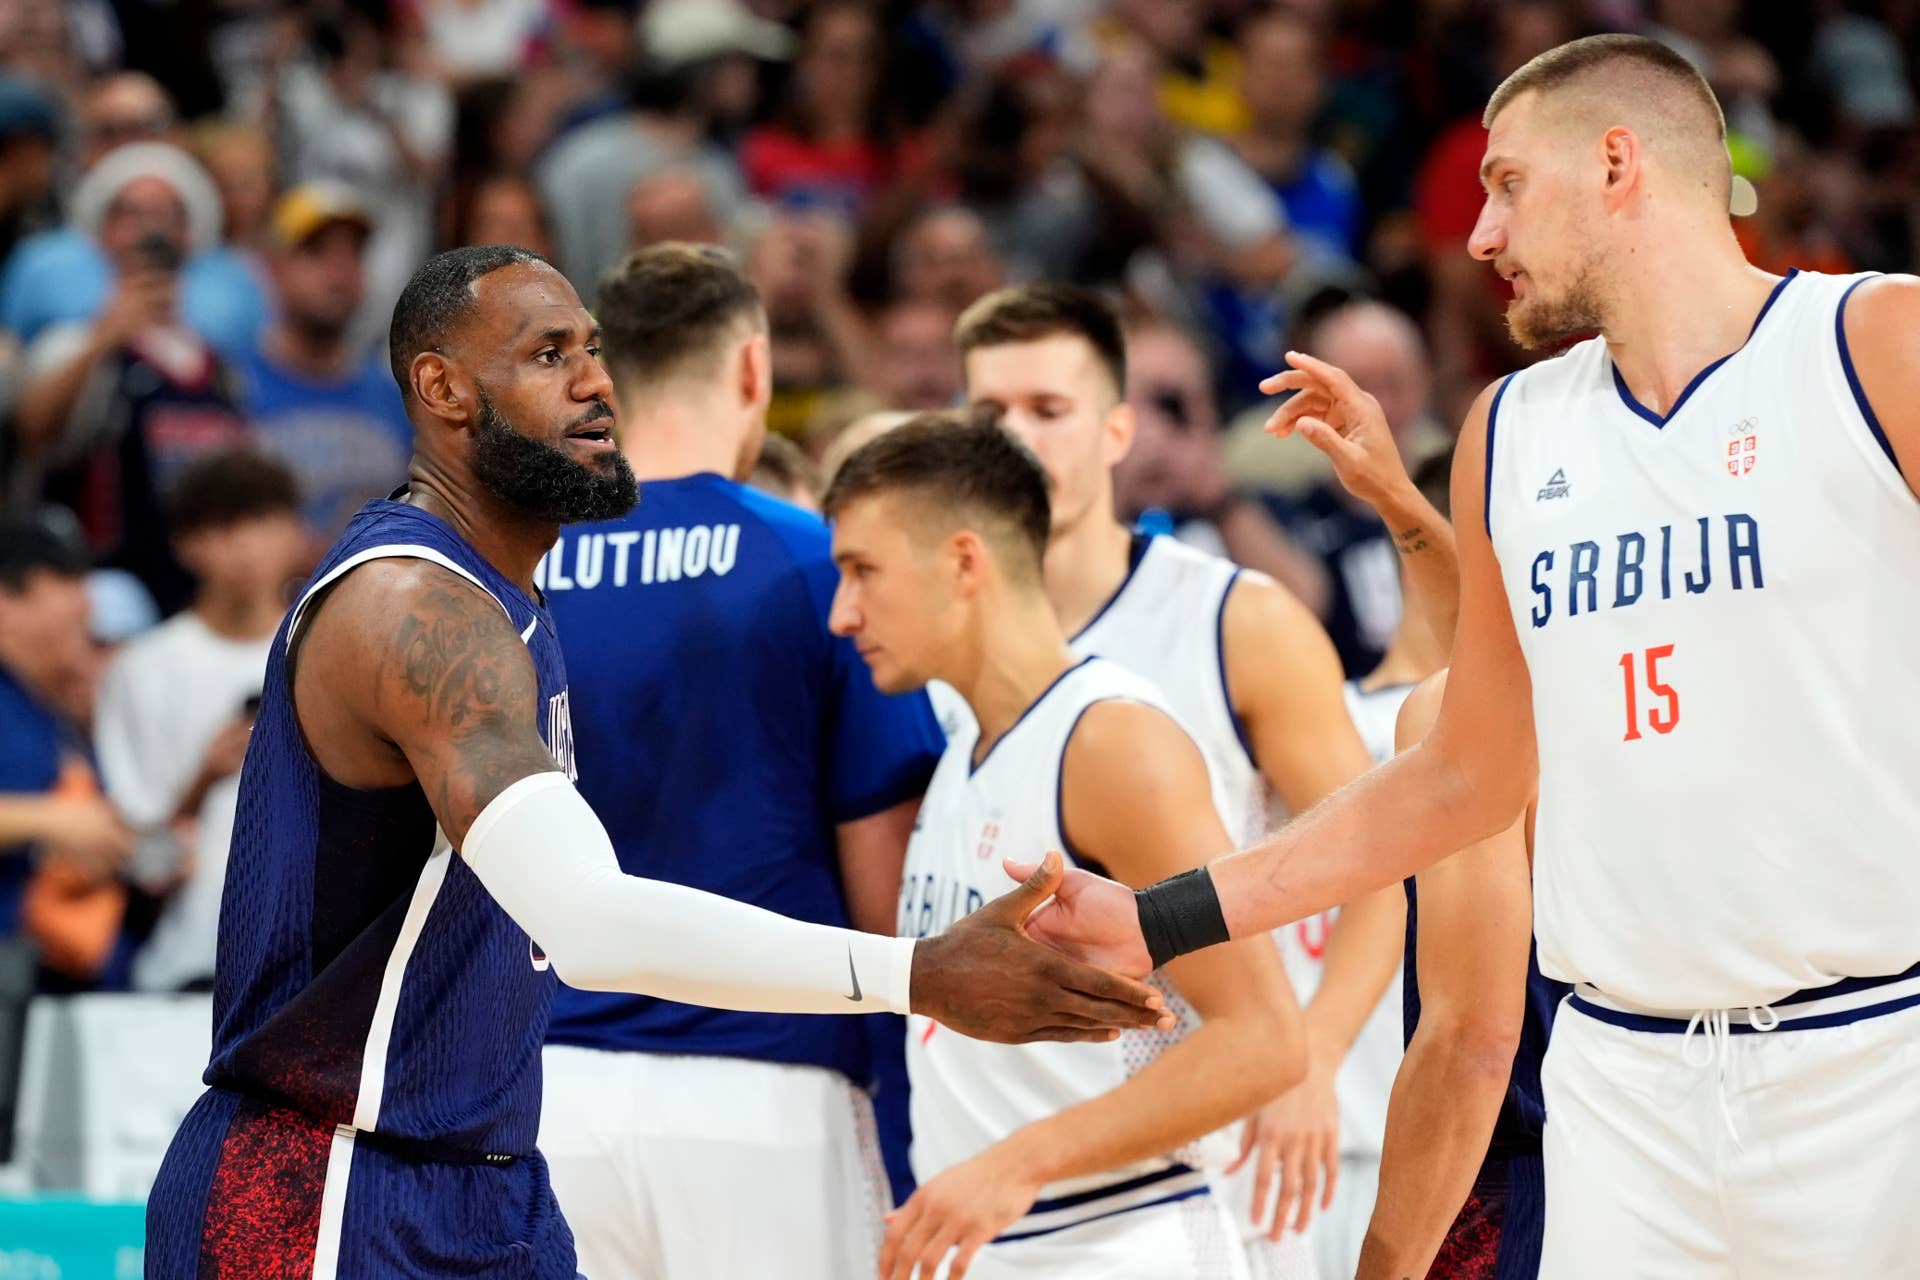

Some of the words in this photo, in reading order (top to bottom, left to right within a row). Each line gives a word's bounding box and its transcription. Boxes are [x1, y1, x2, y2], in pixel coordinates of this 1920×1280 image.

[1536, 483, 1571, 502] PEAK
[1531, 513, 1764, 629] SRBIJA
[1618, 643, 1680, 742] 15
